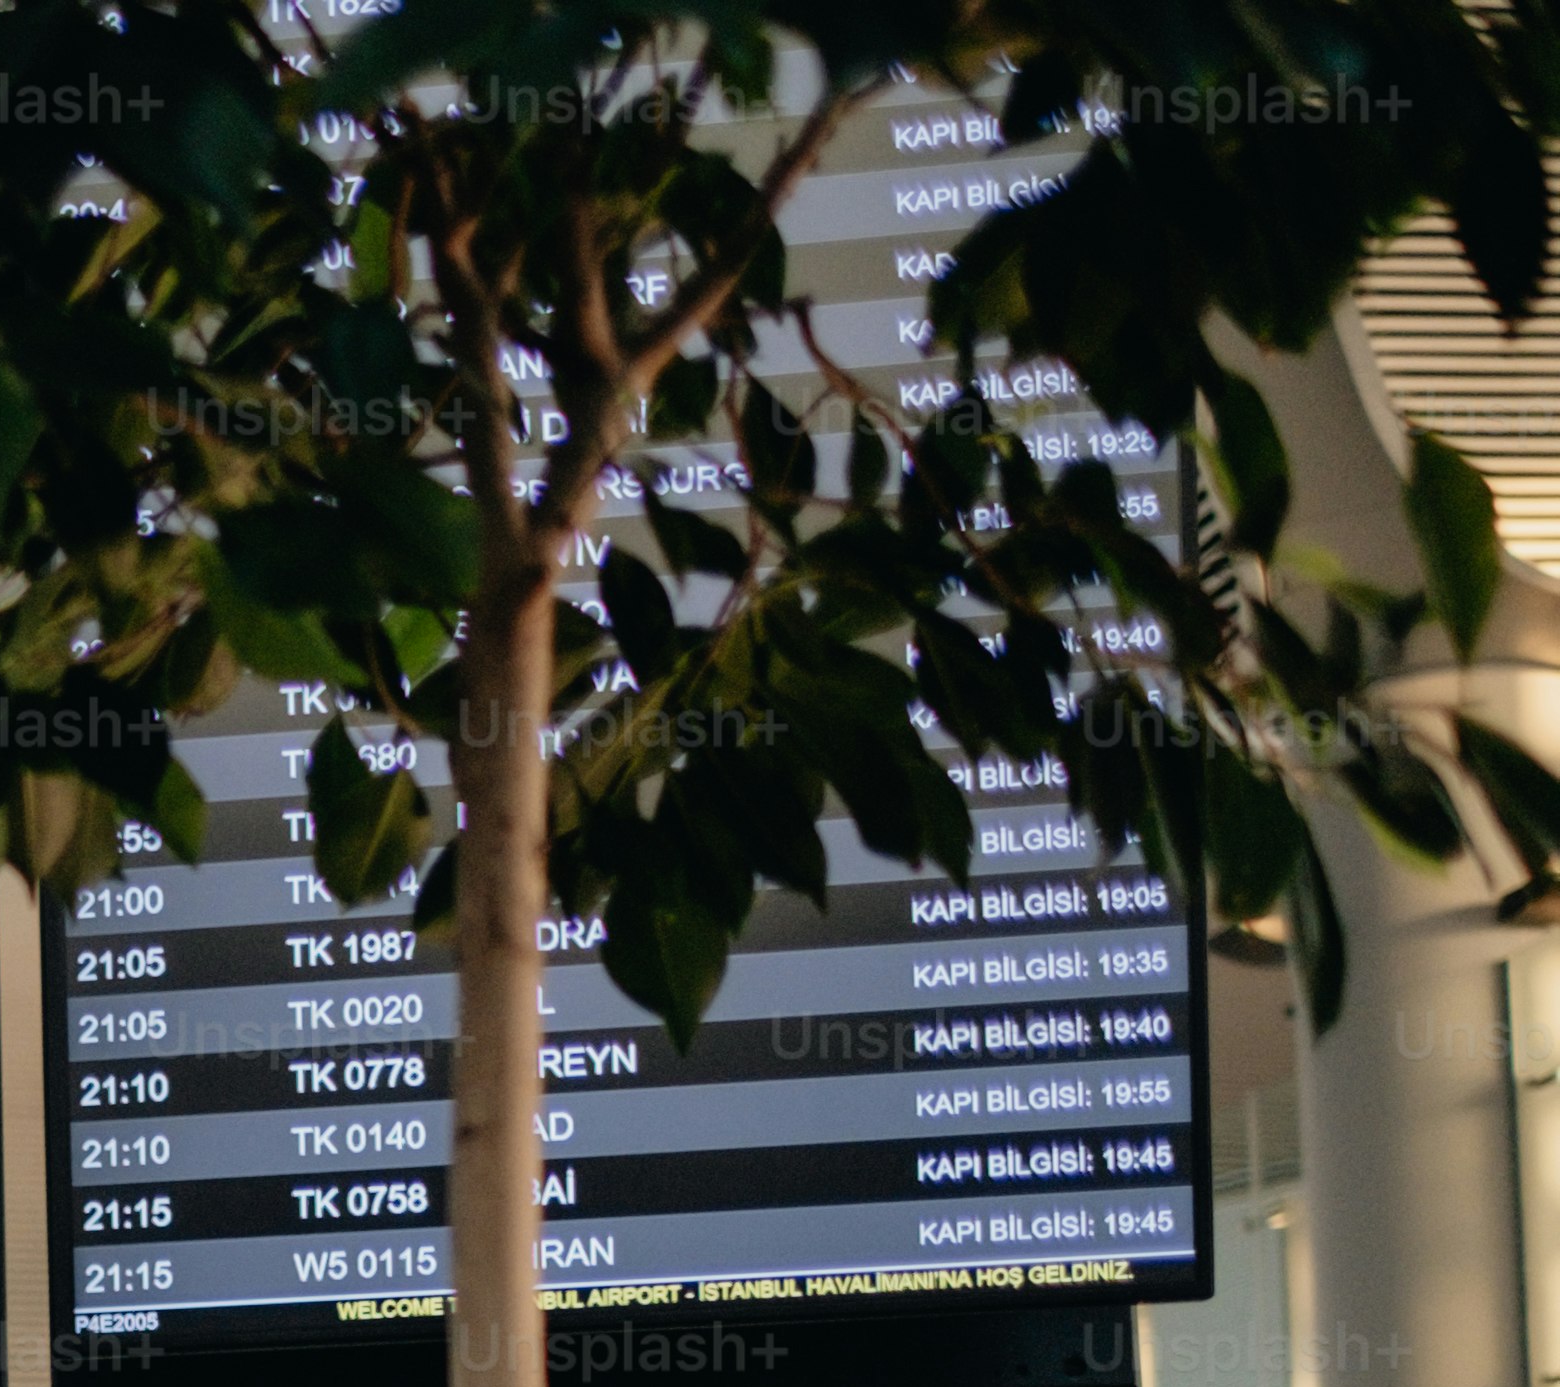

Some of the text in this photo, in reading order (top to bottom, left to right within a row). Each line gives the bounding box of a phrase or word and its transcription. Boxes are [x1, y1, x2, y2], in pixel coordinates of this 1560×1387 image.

[80, 1010, 1171, 1107] 21:10 TK 0778 REYN KAPI BİLGİSİ: 19:40
[85, 1259, 174, 1294] 21:15
[293, 1250, 348, 1283] W5
[357, 1245, 438, 1279] 0115
[919, 1218, 982, 1246] KAPI
[989, 1209, 1095, 1242] BİLGİSİ:
[1104, 1207, 1174, 1236] 19:45
